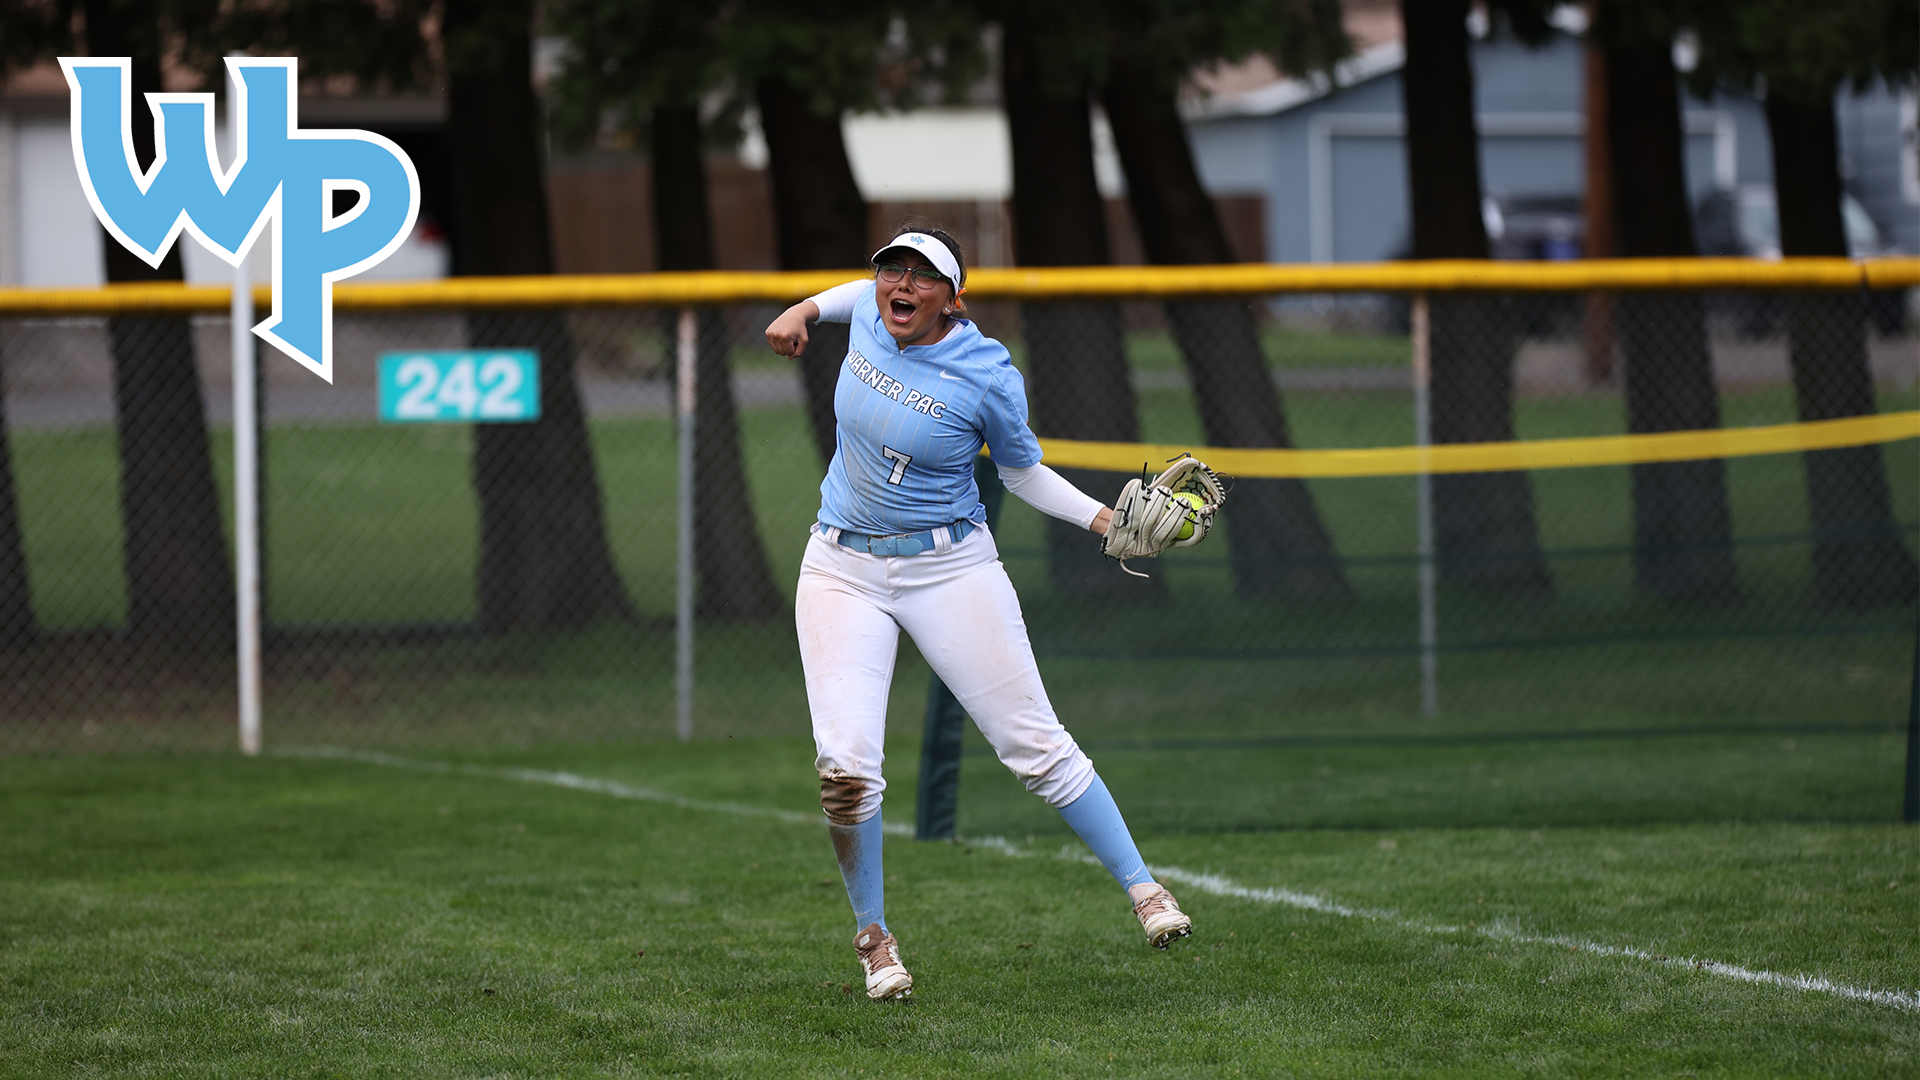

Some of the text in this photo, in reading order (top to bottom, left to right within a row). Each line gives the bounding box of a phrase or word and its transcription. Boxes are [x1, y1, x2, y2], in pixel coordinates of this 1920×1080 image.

[395, 354, 524, 419] 242
[847, 347, 904, 402] WARNER
[882, 444, 913, 486] 7
